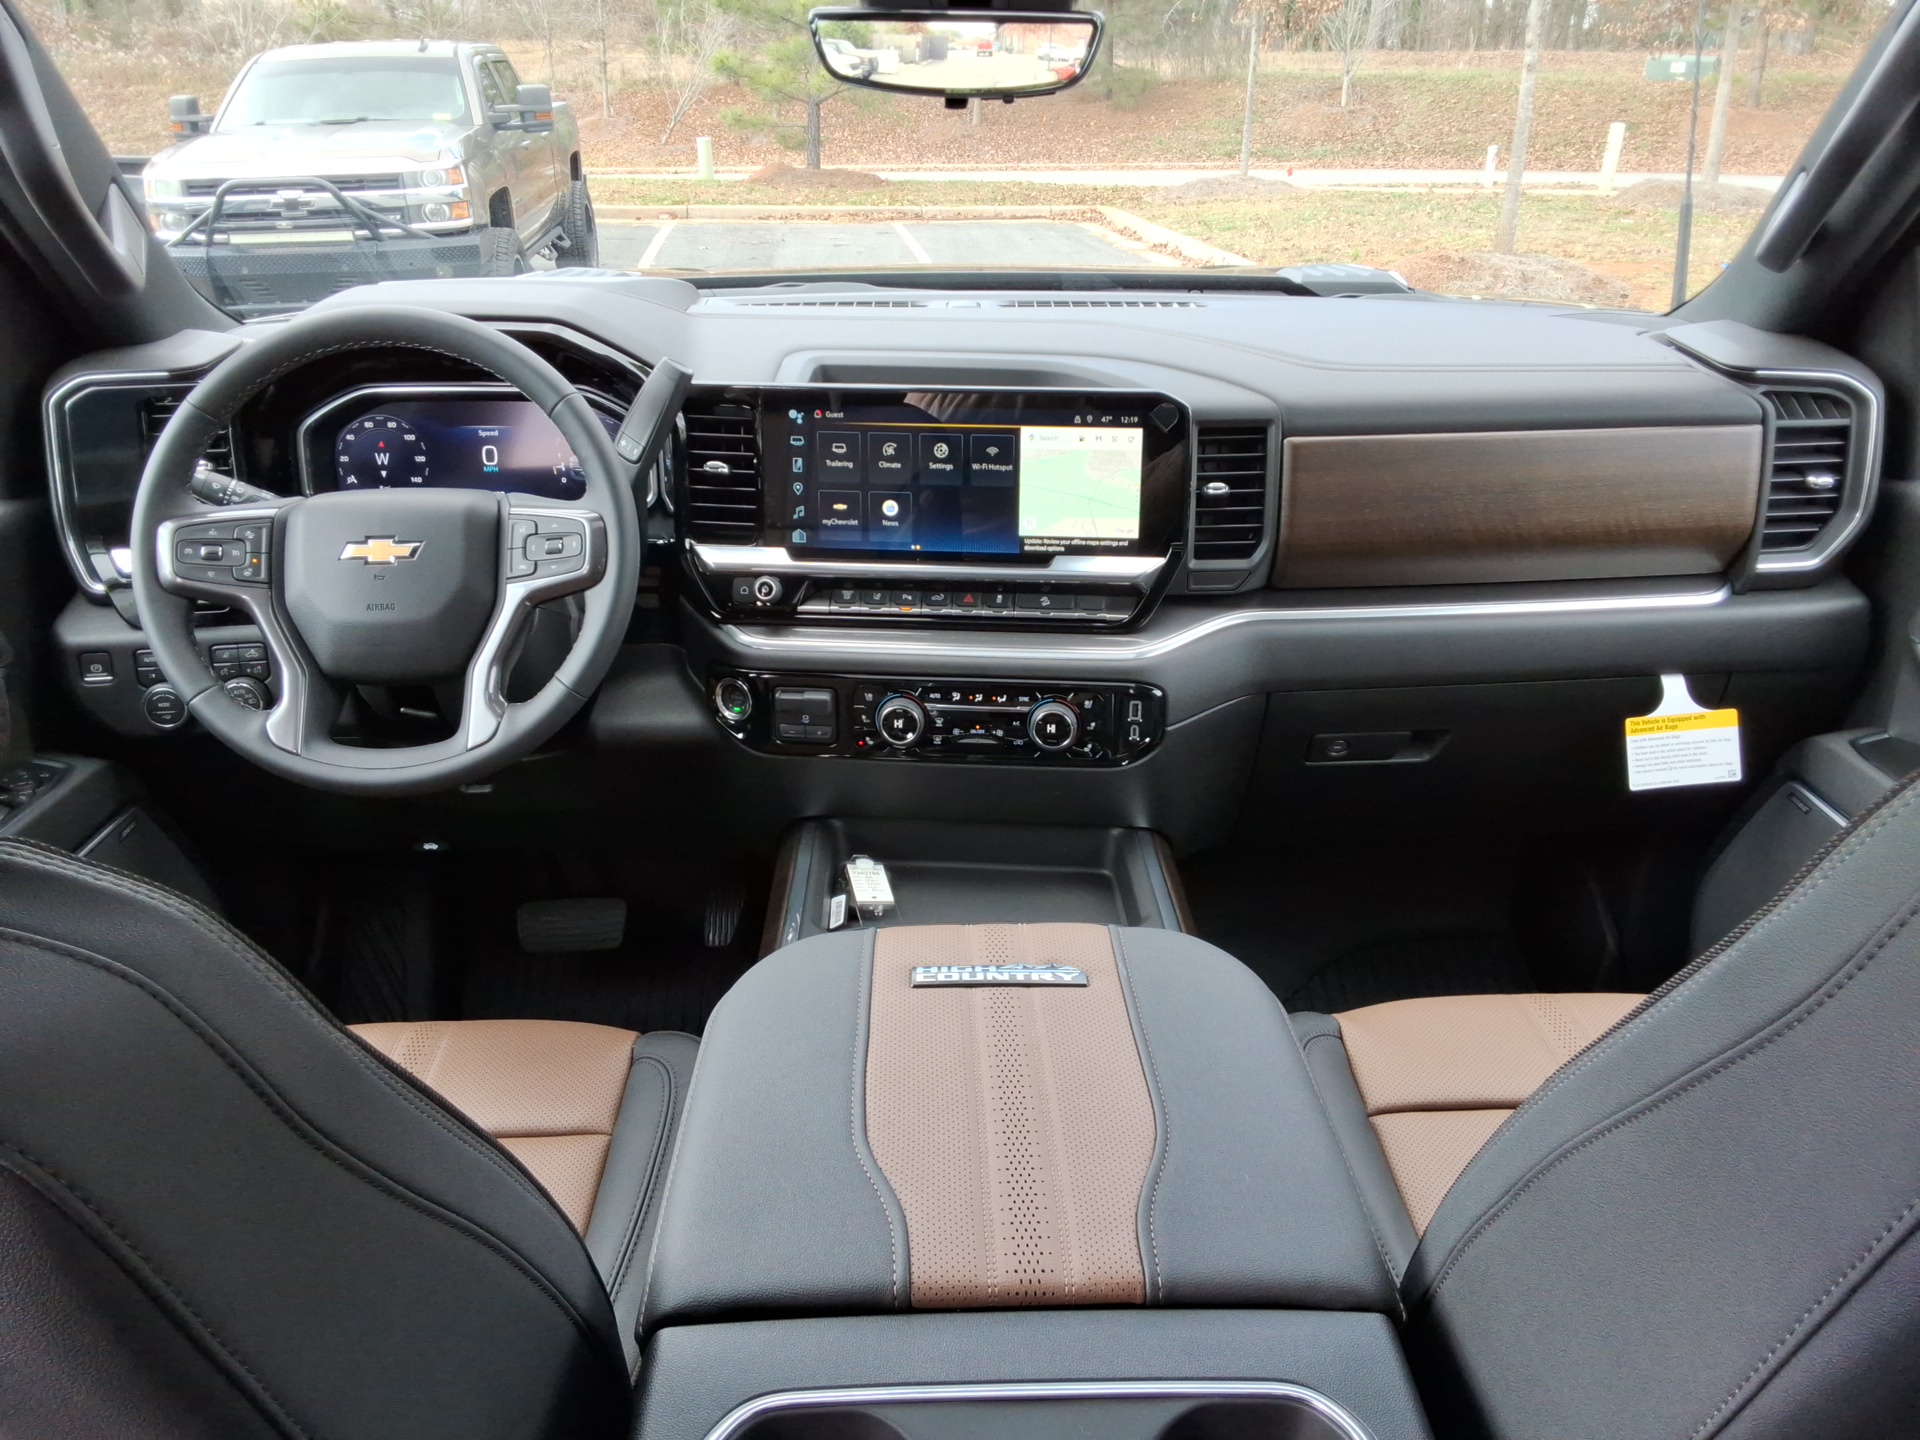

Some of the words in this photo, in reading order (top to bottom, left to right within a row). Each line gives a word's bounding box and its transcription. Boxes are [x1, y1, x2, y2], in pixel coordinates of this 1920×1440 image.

[375, 453, 389, 465] W
[482, 445, 498, 465] 0
[826, 460, 853, 469] Trailering
[929, 462, 954, 471] Settings
[1667, 716, 1692, 724] Equipped
[1047, 724, 1056, 734] HI
[916, 972, 1082, 982] COUNTRY
